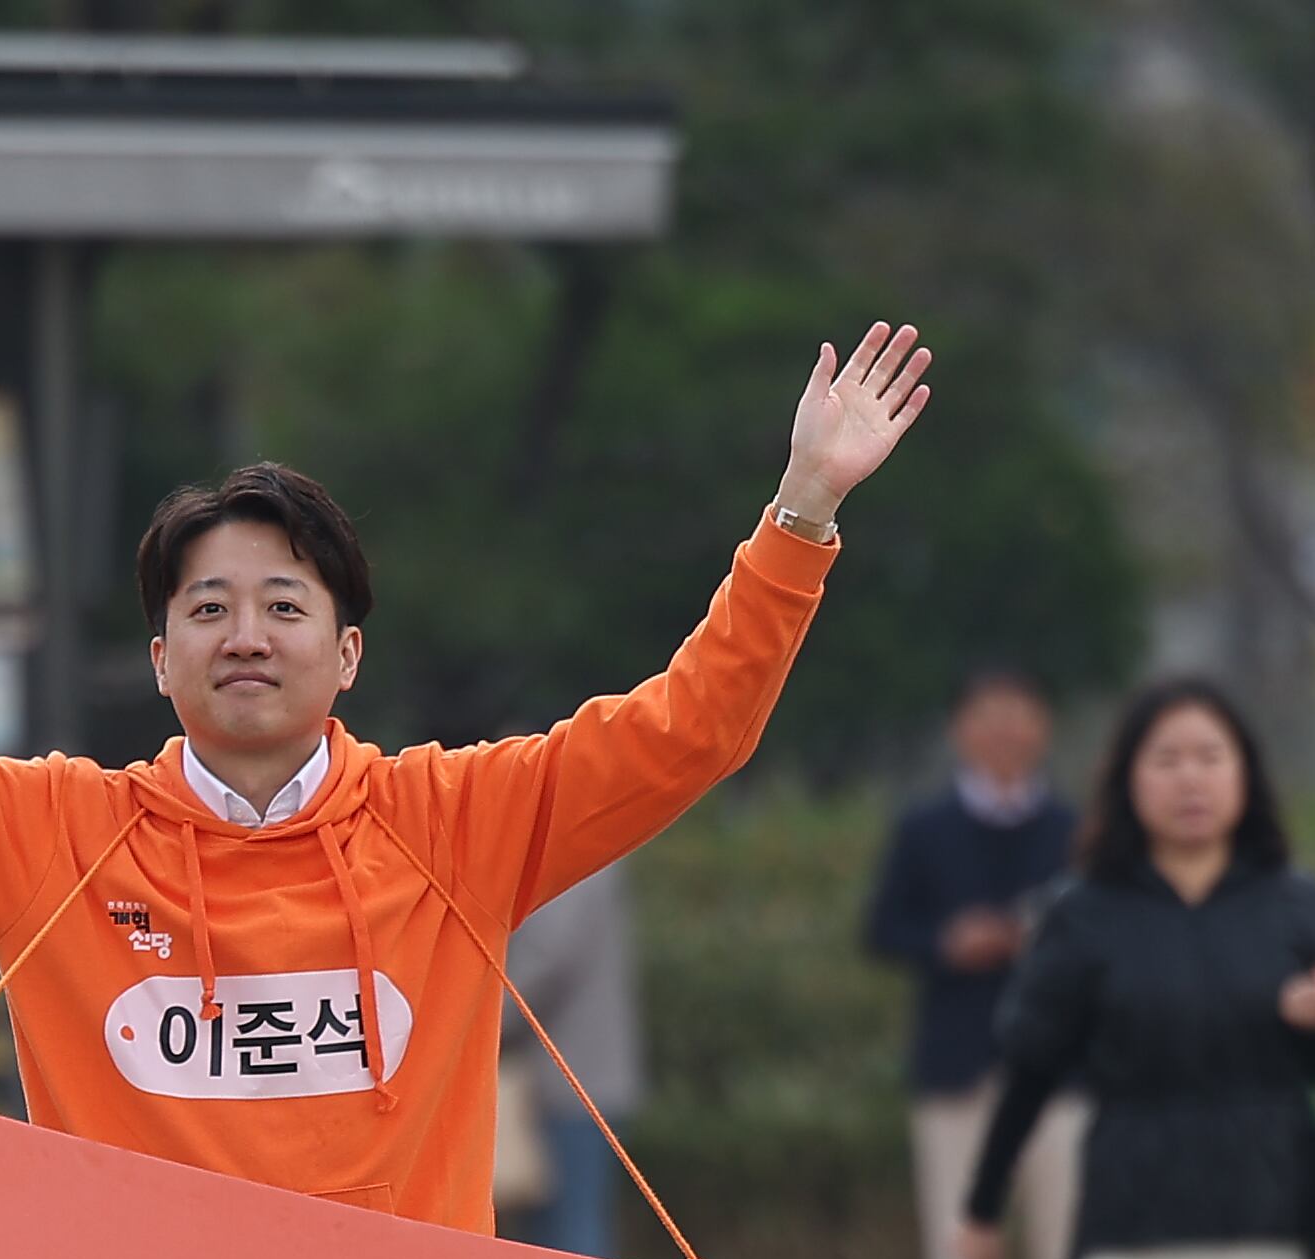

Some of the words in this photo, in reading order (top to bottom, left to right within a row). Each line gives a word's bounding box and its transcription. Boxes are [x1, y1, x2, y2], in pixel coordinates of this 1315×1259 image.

[109, 912, 150, 933] 개혁
[128, 930, 172, 959] 신당
[159, 994, 369, 1077] 이준석
